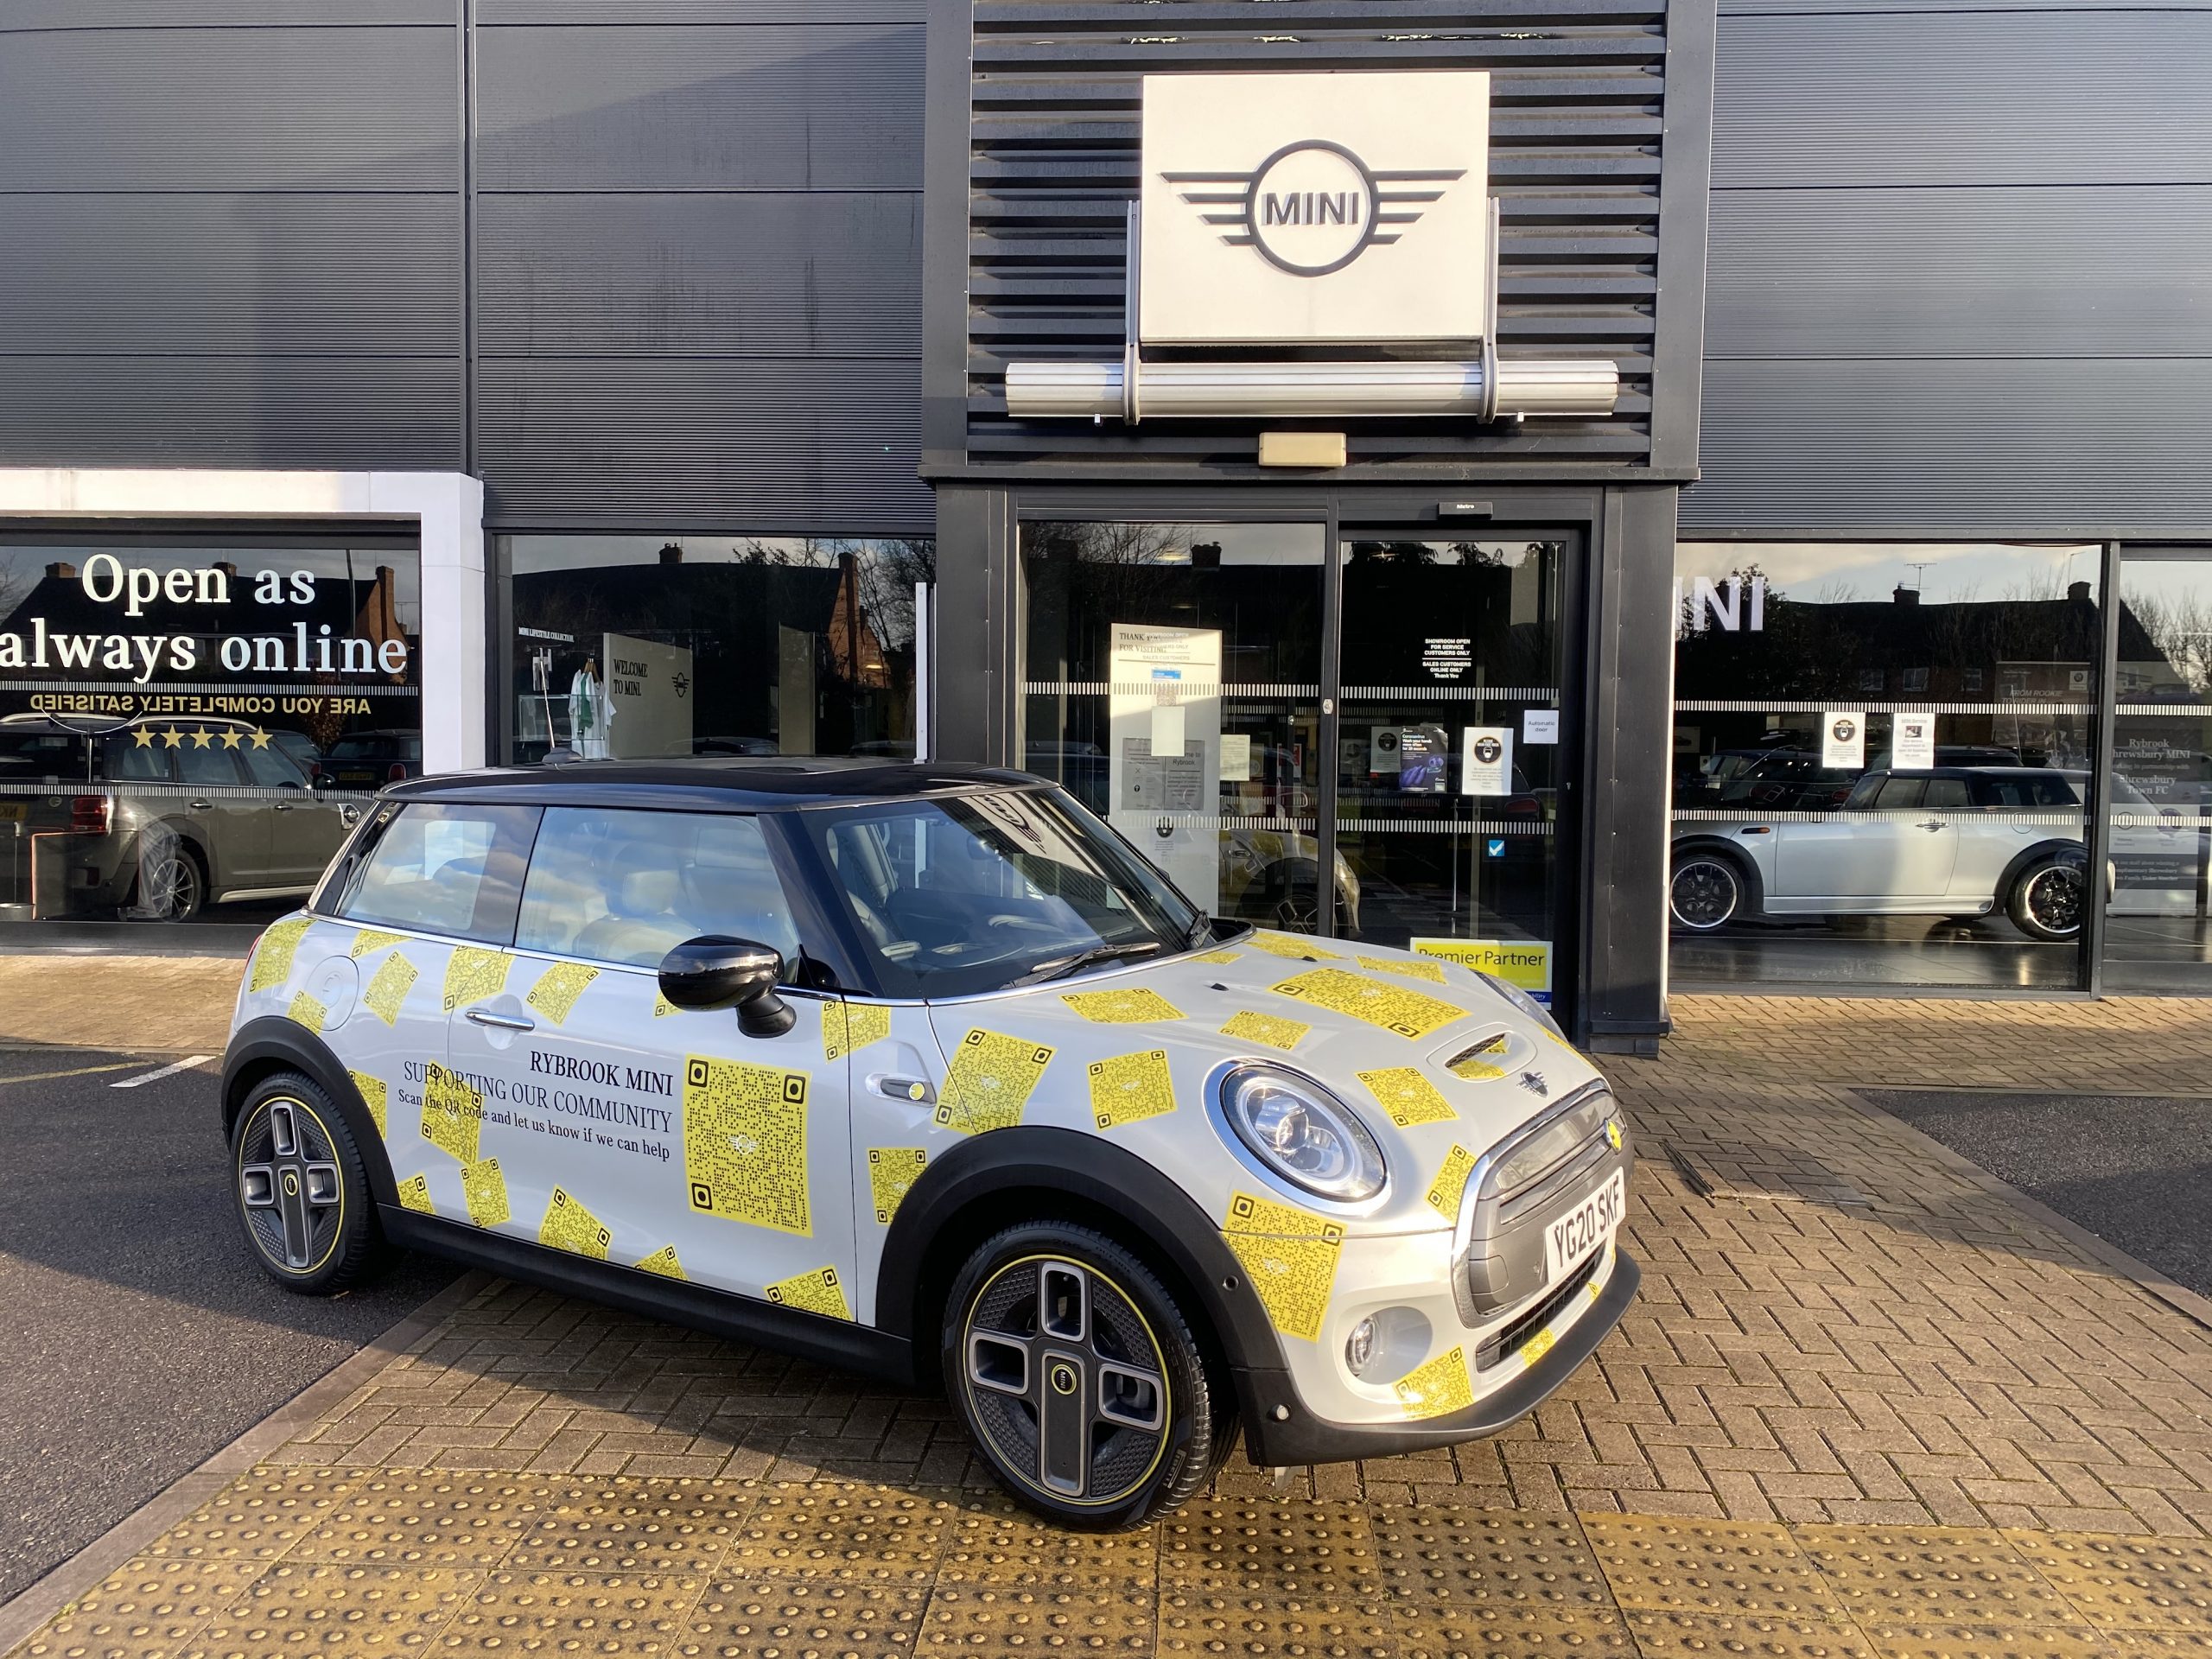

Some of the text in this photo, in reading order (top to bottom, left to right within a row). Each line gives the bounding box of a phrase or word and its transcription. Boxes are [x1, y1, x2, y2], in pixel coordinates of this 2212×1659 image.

[1265, 192, 1359, 226] MINI
[82, 553, 315, 616] Open as
[0, 618, 407, 683] always online
[613, 658, 648, 678] WELCOME
[613, 679, 624, 695] TO
[2113, 749, 2190, 760] hrewsbury MINI
[2129, 738, 2170, 748] Rybrook
[2119, 774, 2177, 786] Shrewsbury
[2155, 785, 2169, 794] FC
[1484, 950, 1544, 966] Partner
[530, 1051, 674, 1096] RYBROOK MINI
[404, 1060, 673, 1133] SUPPORTING OUR COMMUNITY
[398, 1089, 671, 1163] Scan the QR code and let us know if we can help
[1554, 1175, 1619, 1268] YG20 SKF
